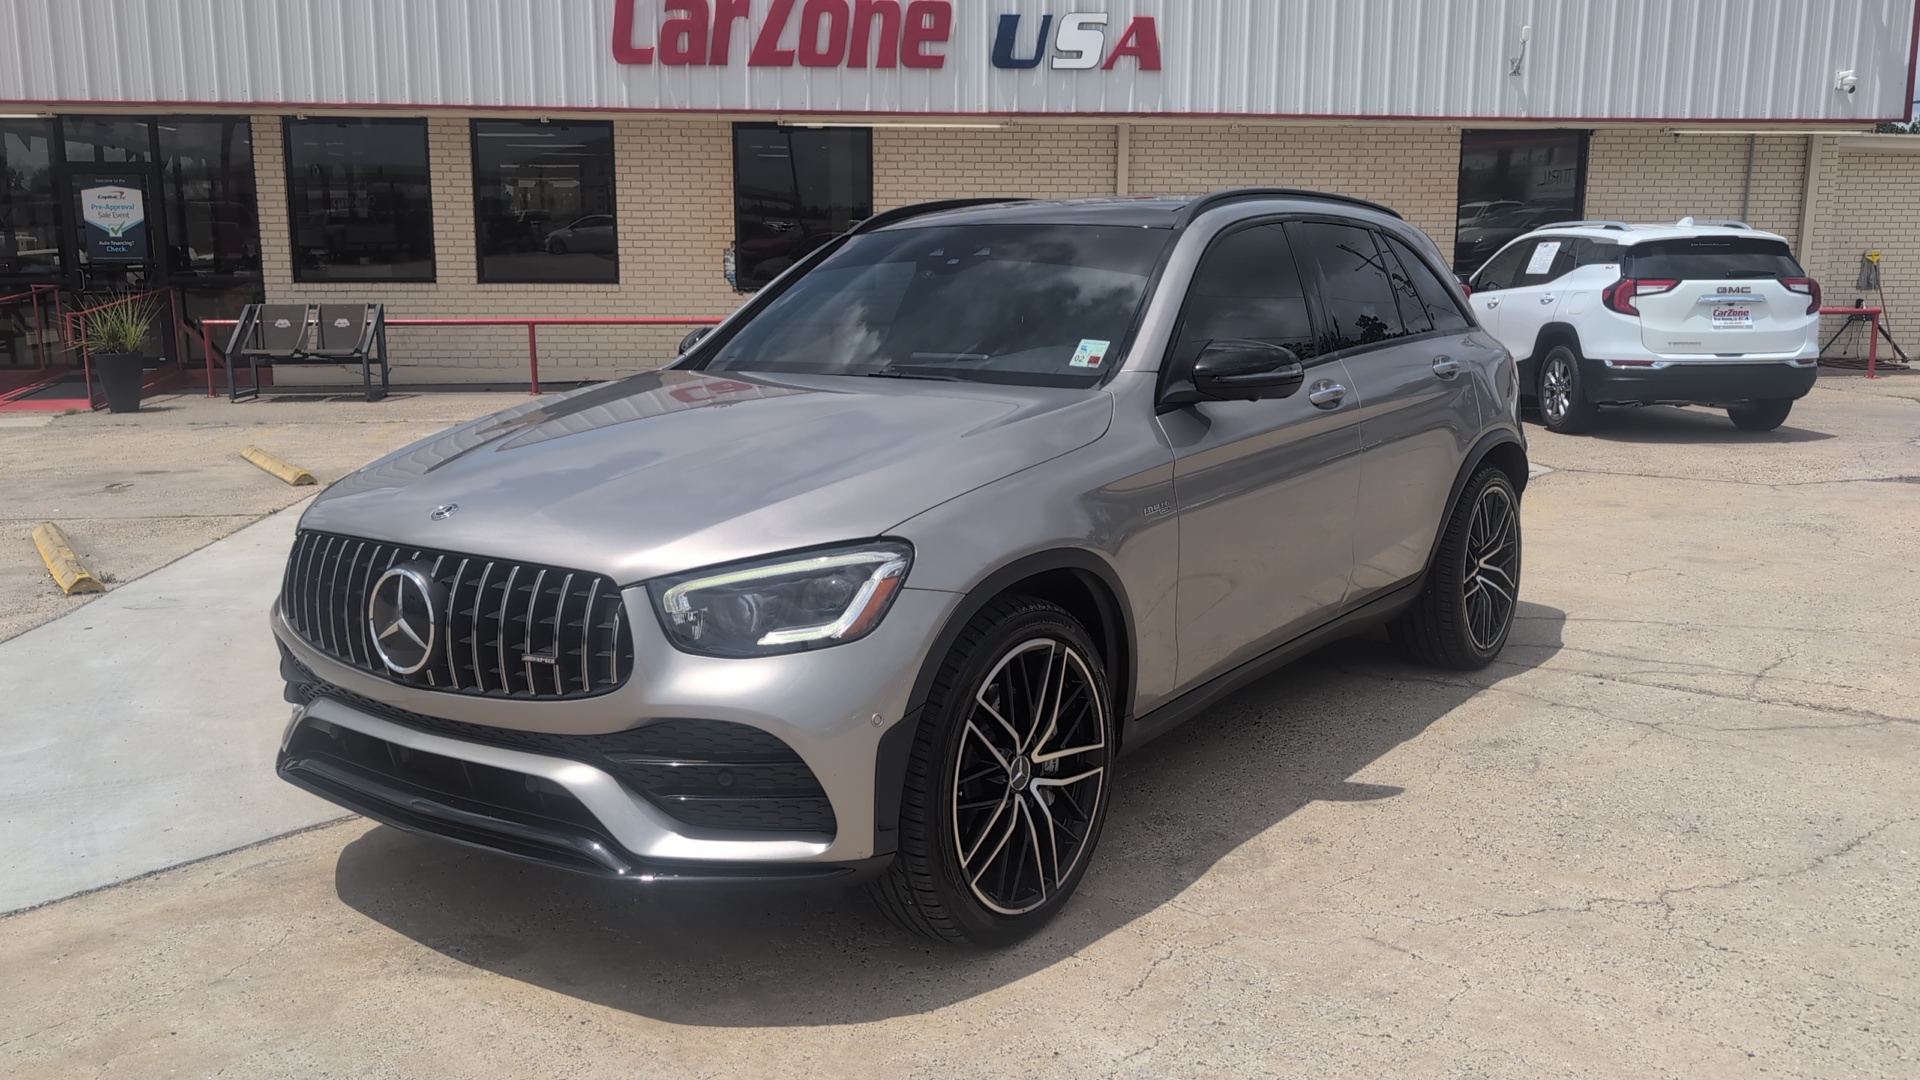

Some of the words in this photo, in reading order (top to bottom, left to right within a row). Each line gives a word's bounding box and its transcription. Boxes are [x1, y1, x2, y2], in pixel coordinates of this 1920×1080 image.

[612, 0, 952, 68] CarZone
[991, 12, 1161, 70] USA
[91, 203, 135, 211] Pre-Approval
[97, 211, 112, 219] Sale
[112, 211, 130, 219] Event
[1716, 286, 1752, 294] GMC
[1712, 308, 1750, 317] CarZone
[1074, 354, 1085, 363] 02
